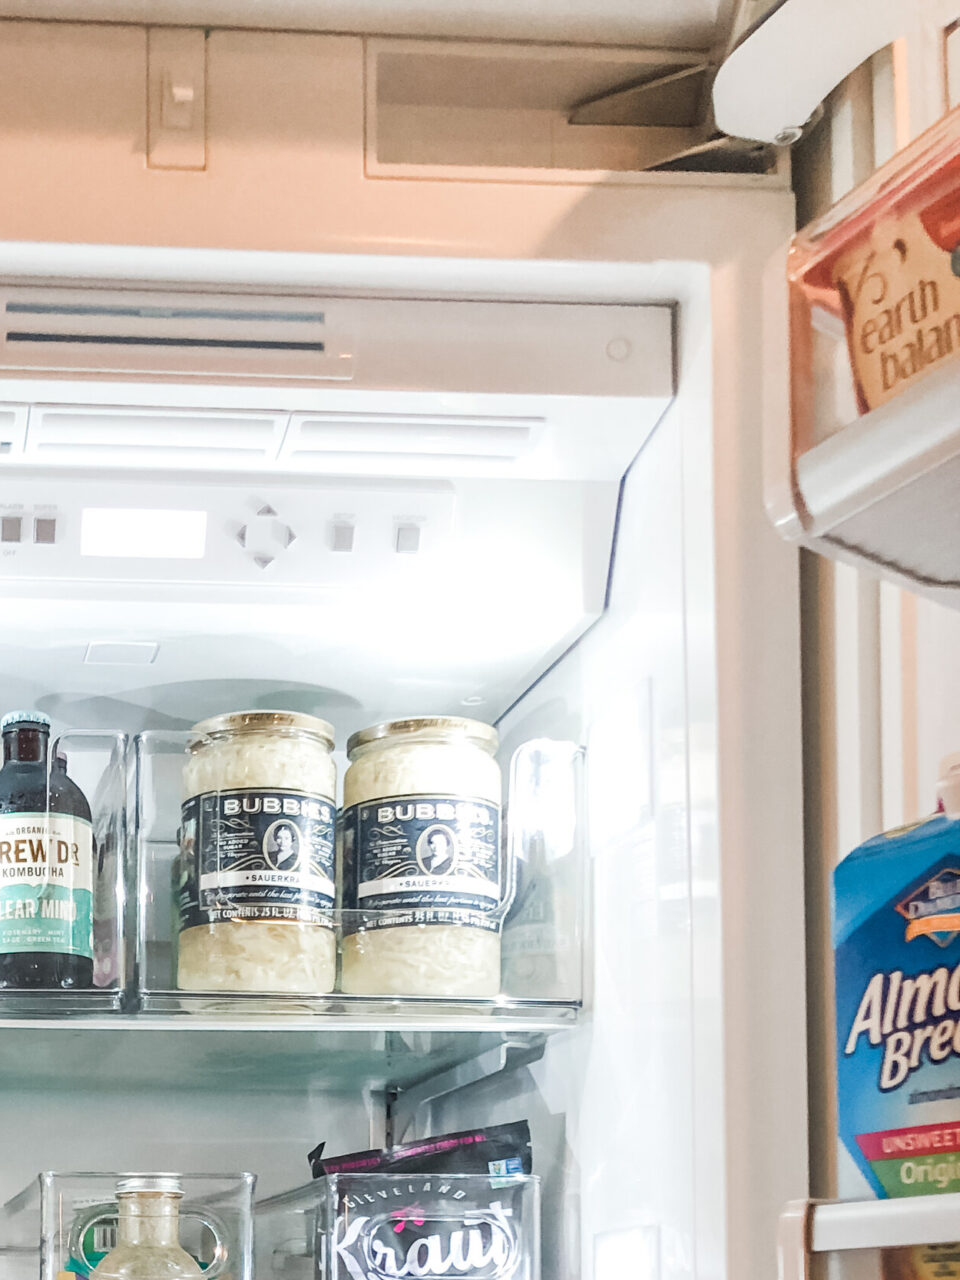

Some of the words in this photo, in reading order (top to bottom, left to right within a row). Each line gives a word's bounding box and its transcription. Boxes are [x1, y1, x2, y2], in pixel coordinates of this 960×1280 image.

[861, 279, 939, 355] earth
[378, 803, 493, 827] BUBB
[251, 874, 301, 885] SAUERKRA
[880, 1019, 960, 1089] Bre
[900, 1156, 960, 1188] Origi
[343, 1182, 466, 1208] CLEVELAND
